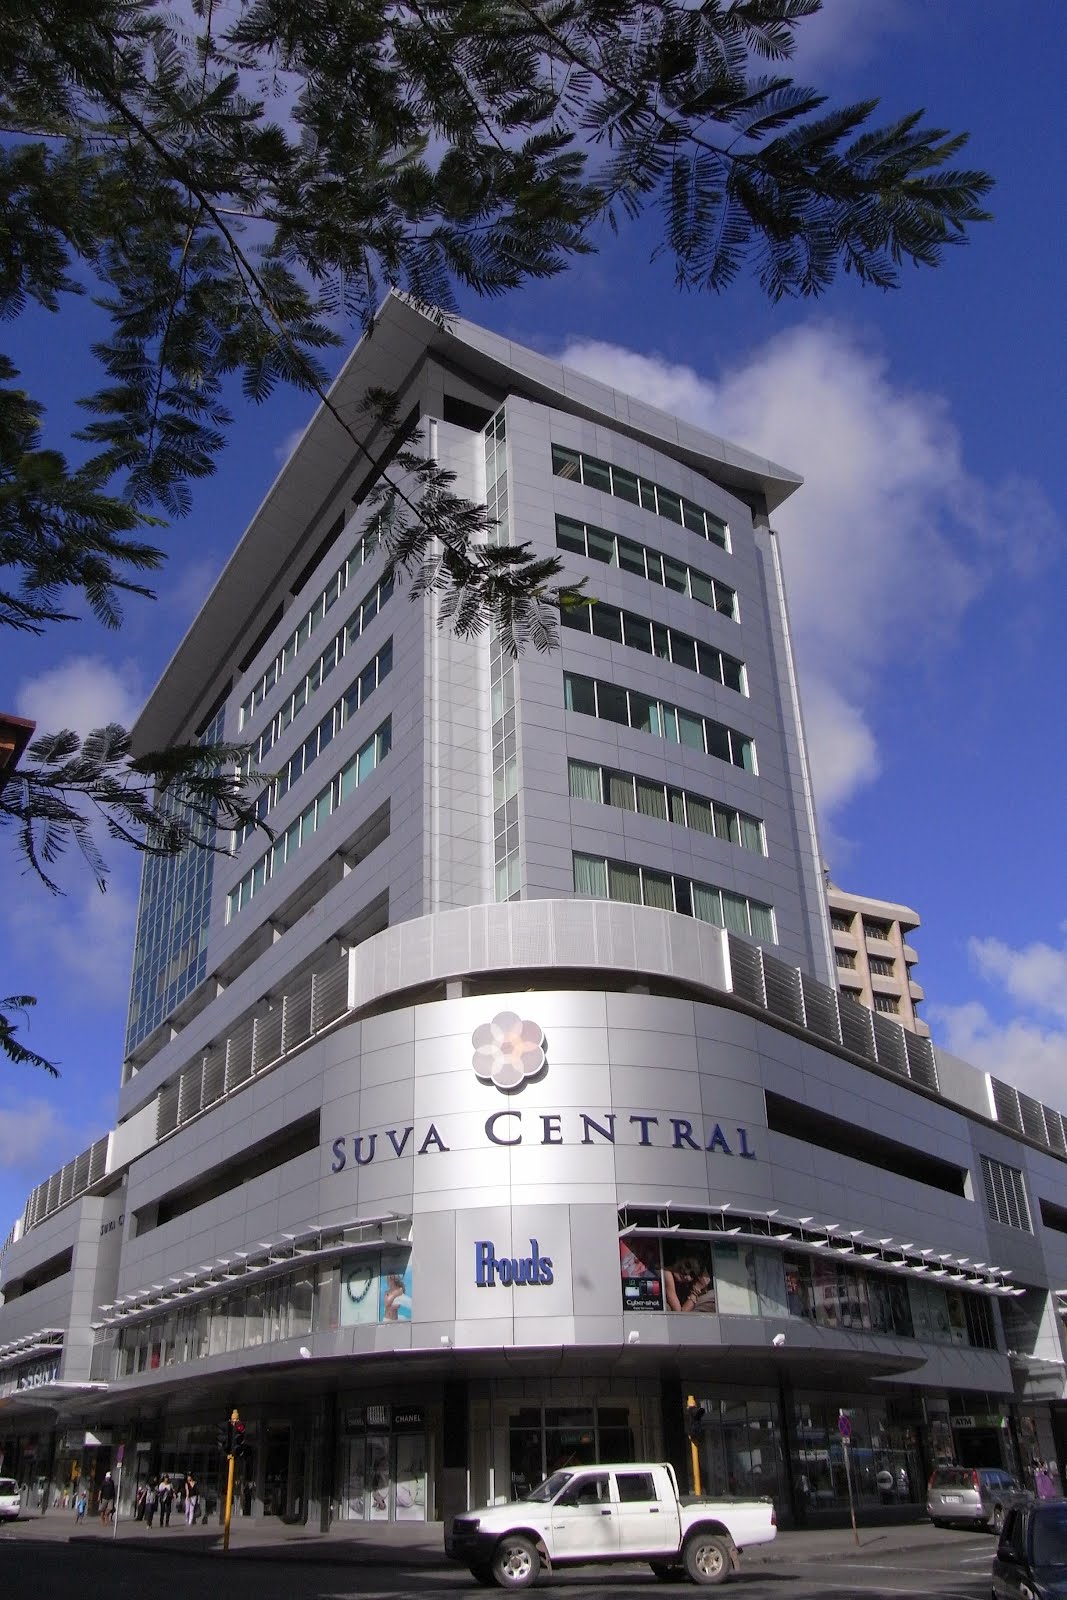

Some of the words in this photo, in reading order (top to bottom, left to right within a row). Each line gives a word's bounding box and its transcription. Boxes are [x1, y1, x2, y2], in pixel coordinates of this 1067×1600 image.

[331, 1123, 450, 1173] SUVA
[484, 1110, 757, 1161] CENTRAL
[474, 1238, 554, 1287] Prouds
[395, 1414, 422, 1424] CHANEL
